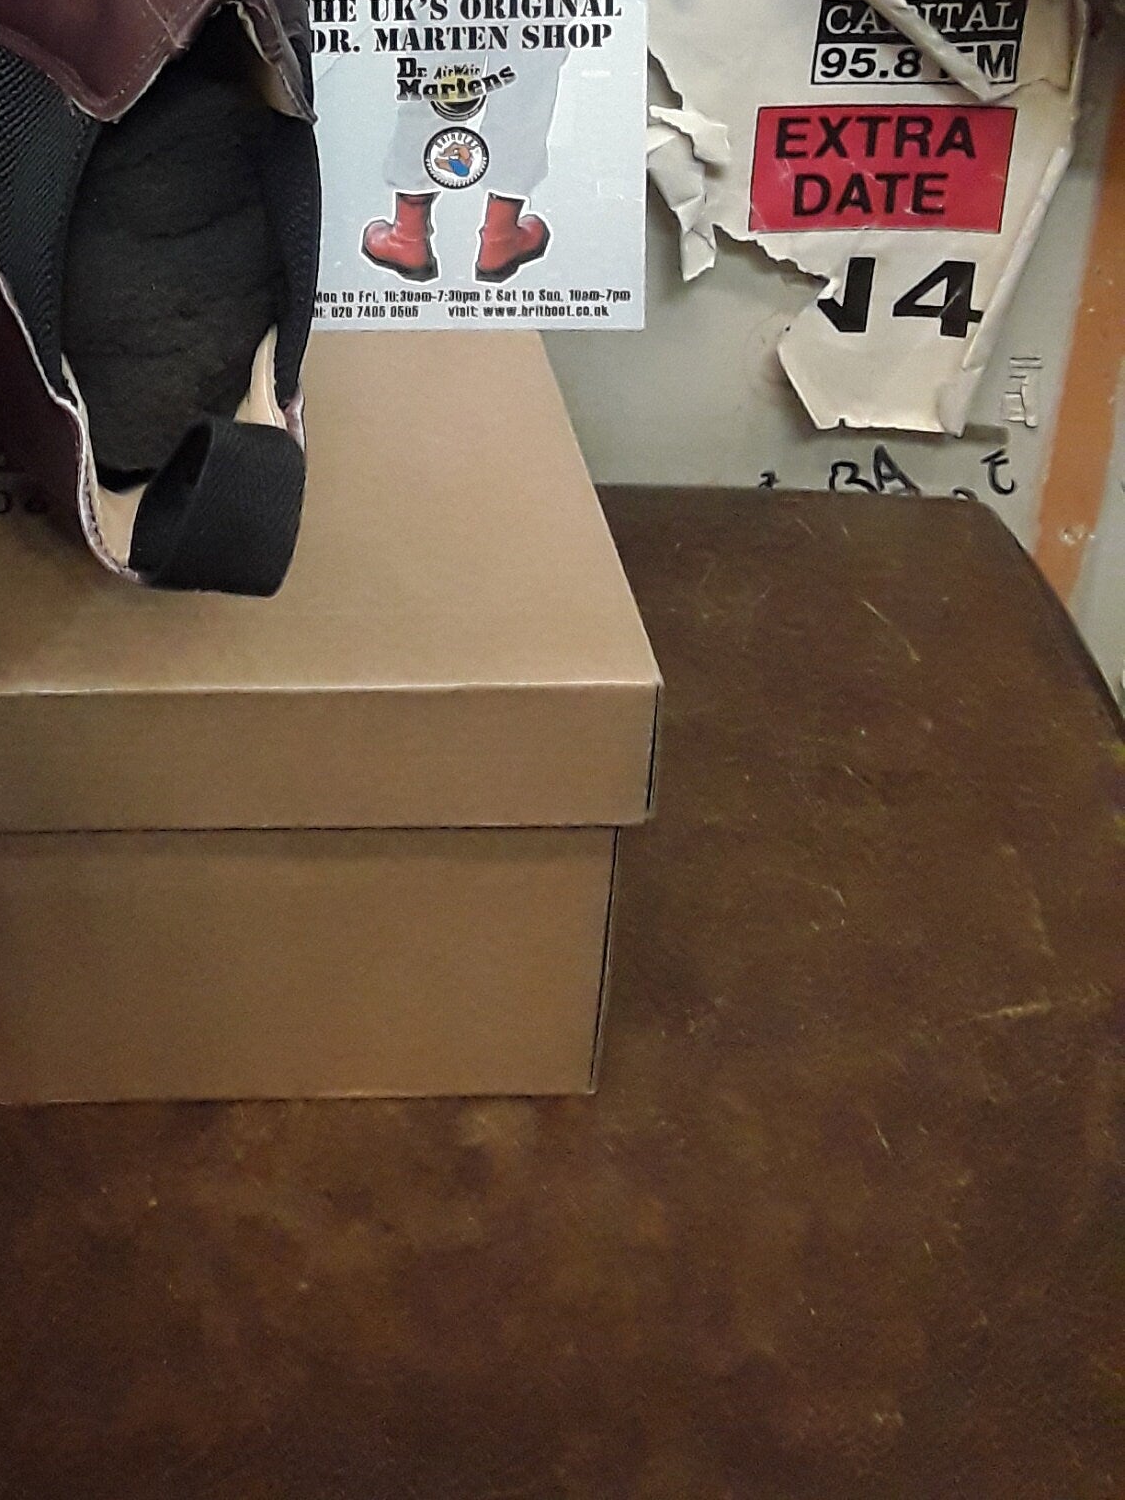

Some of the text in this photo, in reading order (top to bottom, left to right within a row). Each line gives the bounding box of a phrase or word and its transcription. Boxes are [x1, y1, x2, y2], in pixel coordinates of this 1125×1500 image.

[825, 1, 1019, 35] CAITAL
[374, 23, 510, 52] MARTEN
[521, 22, 613, 50] SHOP
[397, 57, 427, 78] Dr.
[820, 47, 922, 79] 95.8
[396, 65, 517, 101] Martens
[775, 115, 976, 160] EXTRA
[792, 172, 950, 218] DATE
[342, 290, 354, 303] to
[496, 288, 517, 302] Sat
[522, 289, 534, 302] to
